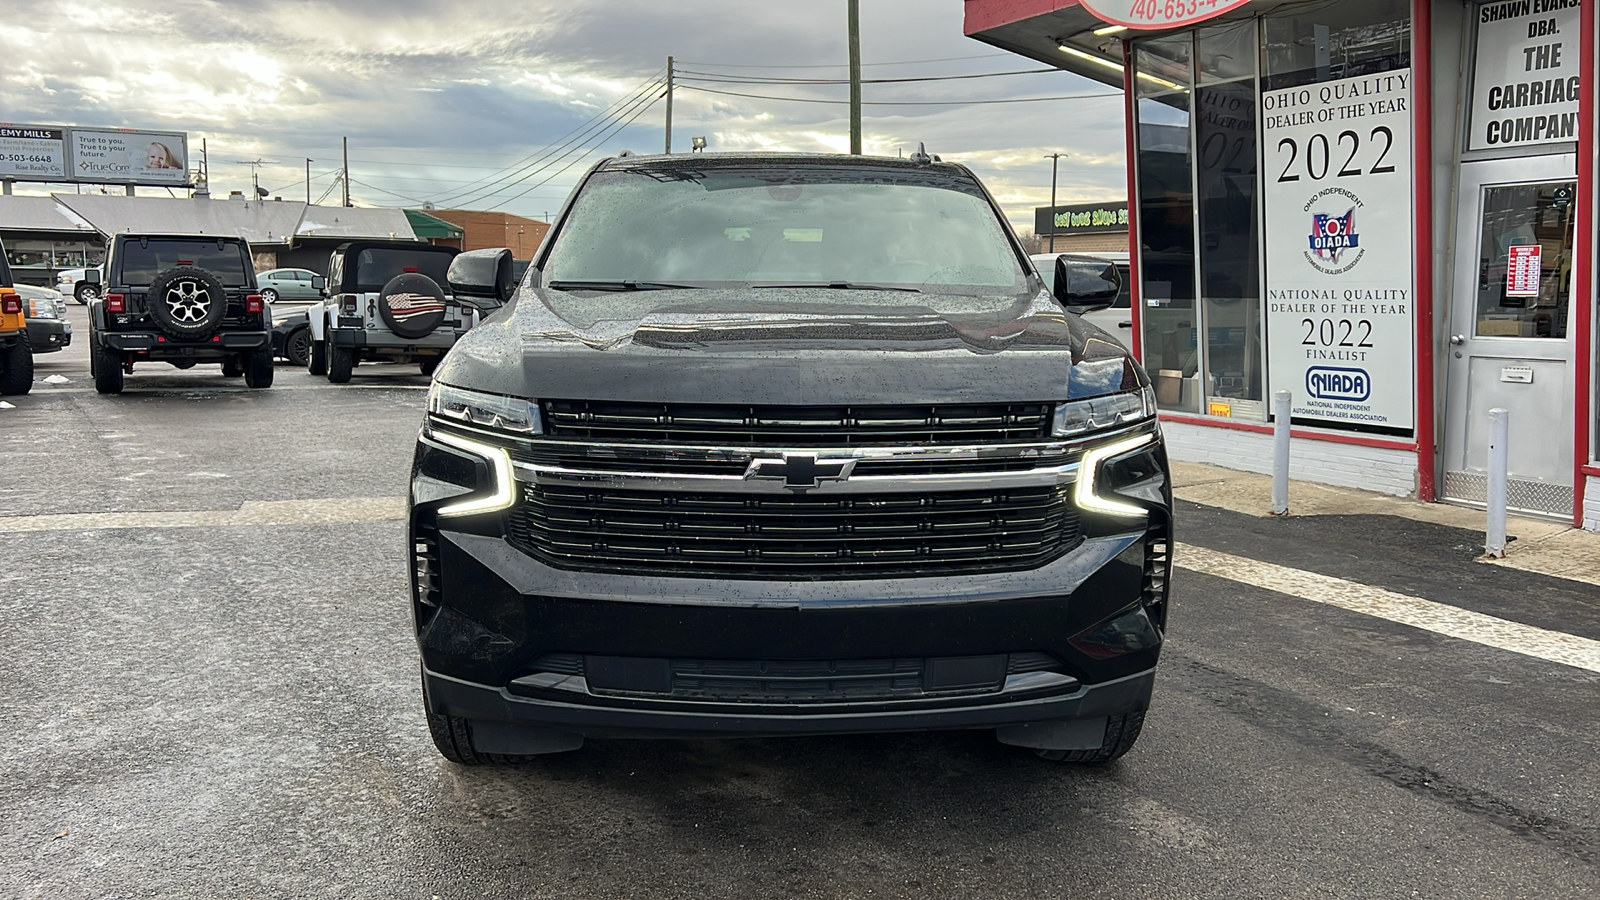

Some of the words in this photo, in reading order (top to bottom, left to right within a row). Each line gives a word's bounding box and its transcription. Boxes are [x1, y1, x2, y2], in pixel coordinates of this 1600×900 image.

[1130, 0, 1229, 20] 740-653-
[1481, 0, 1530, 23] SHAWN
[1528, 18, 1560, 38] DBA.
[1523, 43, 1562, 72] THE
[1264, 90, 1311, 110] OHIO
[1319, 73, 1409, 105] QUALITY
[1489, 76, 1580, 111] CARRIAG
[1266, 111, 1315, 129] DEALER
[1317, 107, 1335, 122] OF
[1338, 103, 1366, 119] THE
[1368, 97, 1407, 115] YEAR
[23, 130, 52, 138] MILLS
[1277, 125, 1396, 183] 2022
[30, 164, 49, 173] Realty
[89, 161, 130, 172] TrueCore
[1303, 194, 1319, 212] OHIO
[1318, 187, 1365, 209] INDEPENDENT
[1314, 235, 1350, 248] OIADA
[1303, 250, 1325, 273] AUTOMOBILE
[1342, 248, 1365, 272] ASSOCIATION
[1269, 289, 1338, 300] NATIONAL
[1343, 289, 1408, 302] QUALITY
[1271, 303, 1316, 313] DEALER
[1321, 303, 1337, 313] OF
[1342, 304, 1367, 314] THE
[1371, 304, 1406, 315] YEAR
[1301, 318, 1374, 348] 2022
[1306, 349, 1367, 361] FINALIST
[1311, 373, 1364, 395] NIADA
[1292, 408, 1325, 417] AUTOMOBILE
[1326, 410, 1349, 419] DEALERS
[1349, 413, 1388, 423] ASSOCIATION
[1306, 401, 1333, 409] NATIONAL
[1334, 403, 1371, 412] INDEPENDENT
